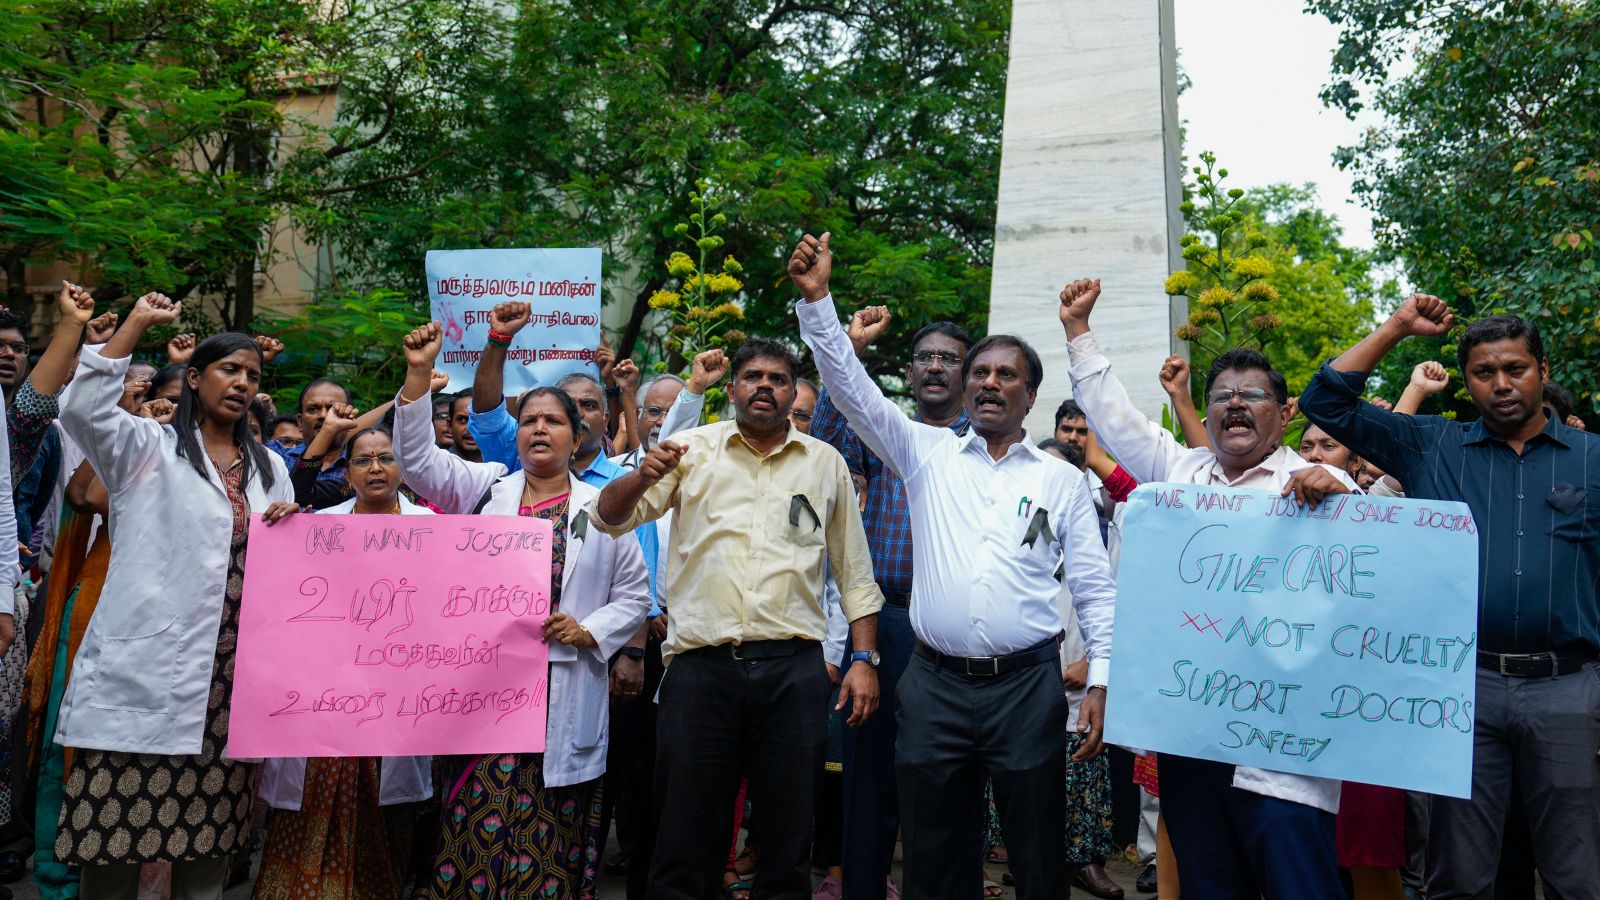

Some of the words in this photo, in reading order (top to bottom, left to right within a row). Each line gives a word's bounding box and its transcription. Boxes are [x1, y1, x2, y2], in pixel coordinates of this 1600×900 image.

[1155, 488, 1185, 509] WE
[1195, 491, 1254, 513] WANT
[1350, 501, 1403, 525] SAVE
[306, 523, 345, 555] WE
[363, 527, 434, 552] WANT
[1178, 524, 1279, 594] GIVE
[1282, 543, 1380, 599] CARE
[1225, 615, 1316, 652] NOT
[1330, 624, 1476, 673] CRUELTY
[1158, 659, 1303, 715] SUPPORT
[1219, 720, 1333, 763] SAFETY
